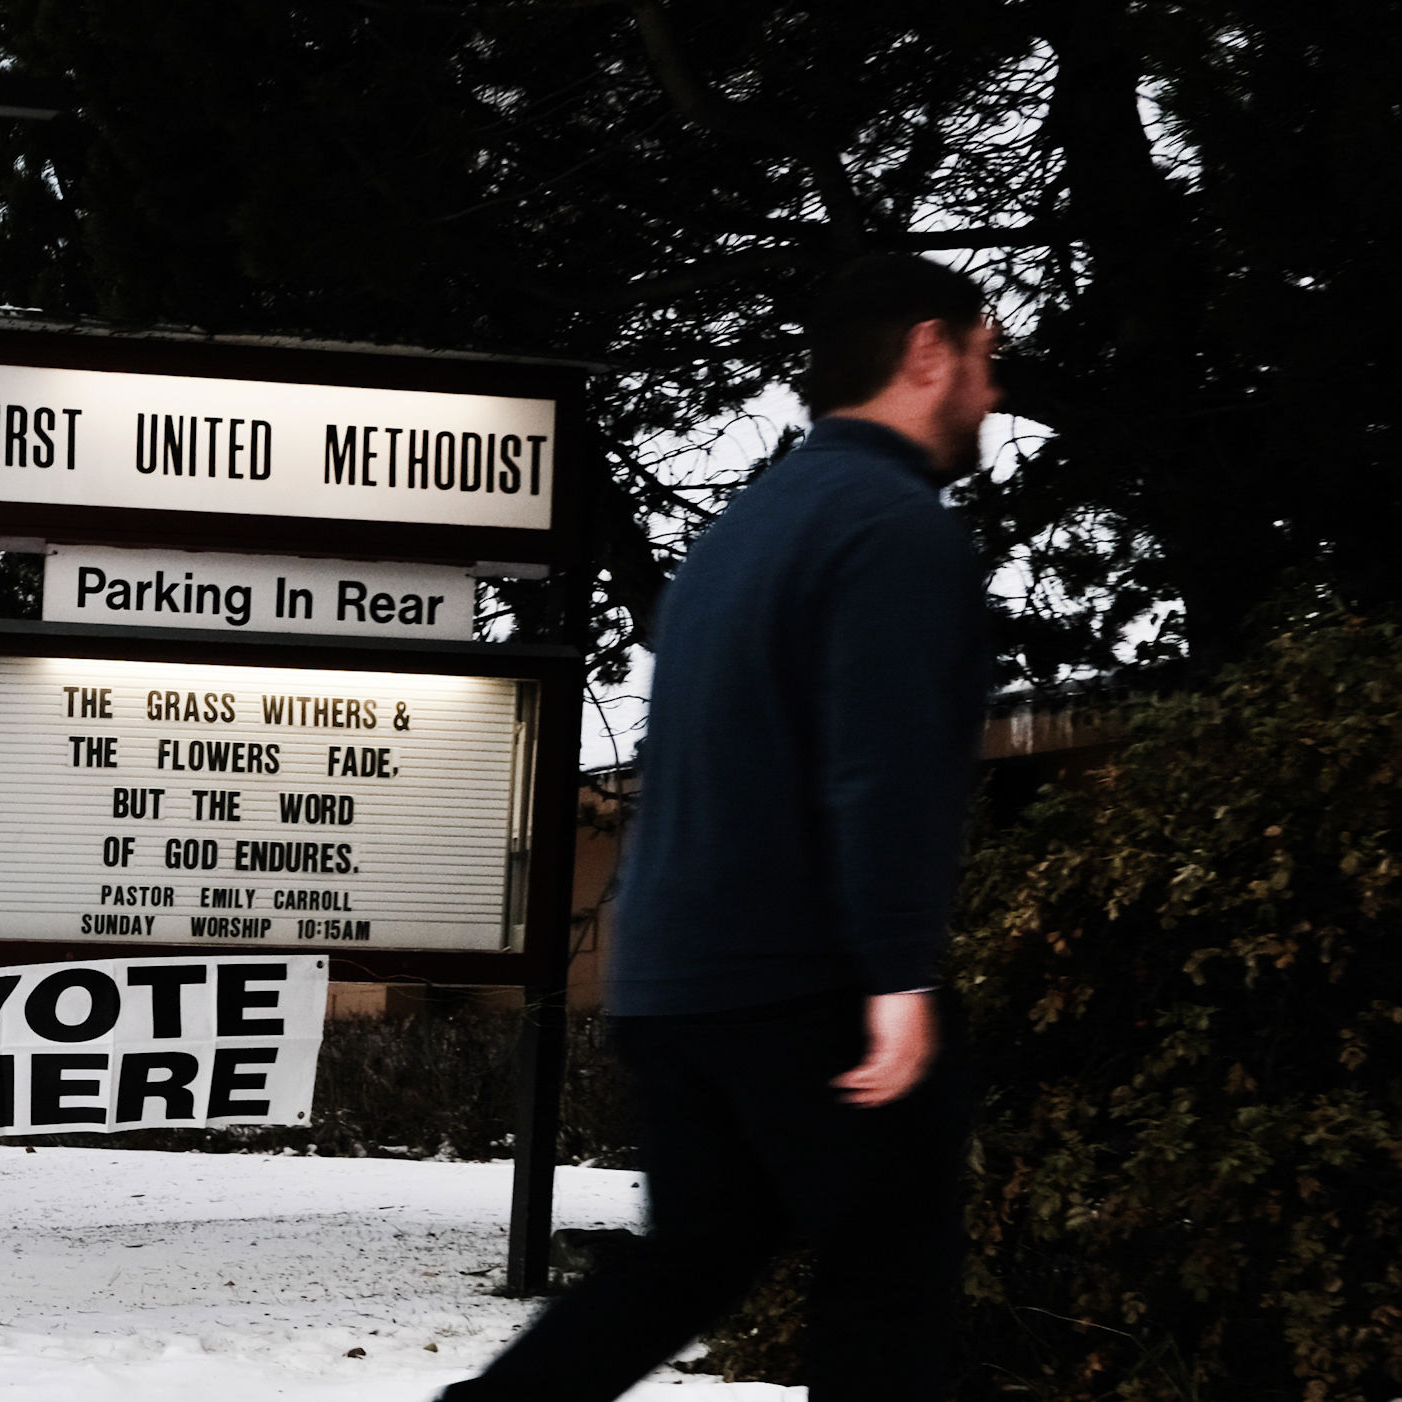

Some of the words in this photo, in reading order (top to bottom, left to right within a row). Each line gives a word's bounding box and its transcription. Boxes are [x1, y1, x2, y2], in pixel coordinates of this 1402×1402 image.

[136, 413, 273, 481] UNITED
[324, 424, 546, 496] METHODIST
[77, 567, 253, 626] Parking
[275, 577, 313, 619] In
[337, 581, 444, 626] Rear
[63, 687, 112, 721] THE
[147, 690, 235, 724] GRASS
[261, 695, 377, 730] WITHERS
[393, 702, 410, 731] &
[69, 736, 118, 768] THE
[158, 740, 280, 775] FLOWERS
[327, 747, 400, 779] FADE,
[112, 788, 164, 820] BUT
[192, 789, 241, 822] THE
[280, 792, 354, 826] WORD
[103, 837, 135, 869] OF
[165, 839, 218, 870] GOD
[235, 840, 360, 875] ENDURES.
[100, 884, 174, 908] PASTOR
[200, 886, 256, 910] EMILY
[273, 888, 352, 912] CARROLL
[81, 913, 155, 937] SUNDAY
[190, 916, 271, 939] WORSHIP
[297, 919, 370, 941] 10:15AM
